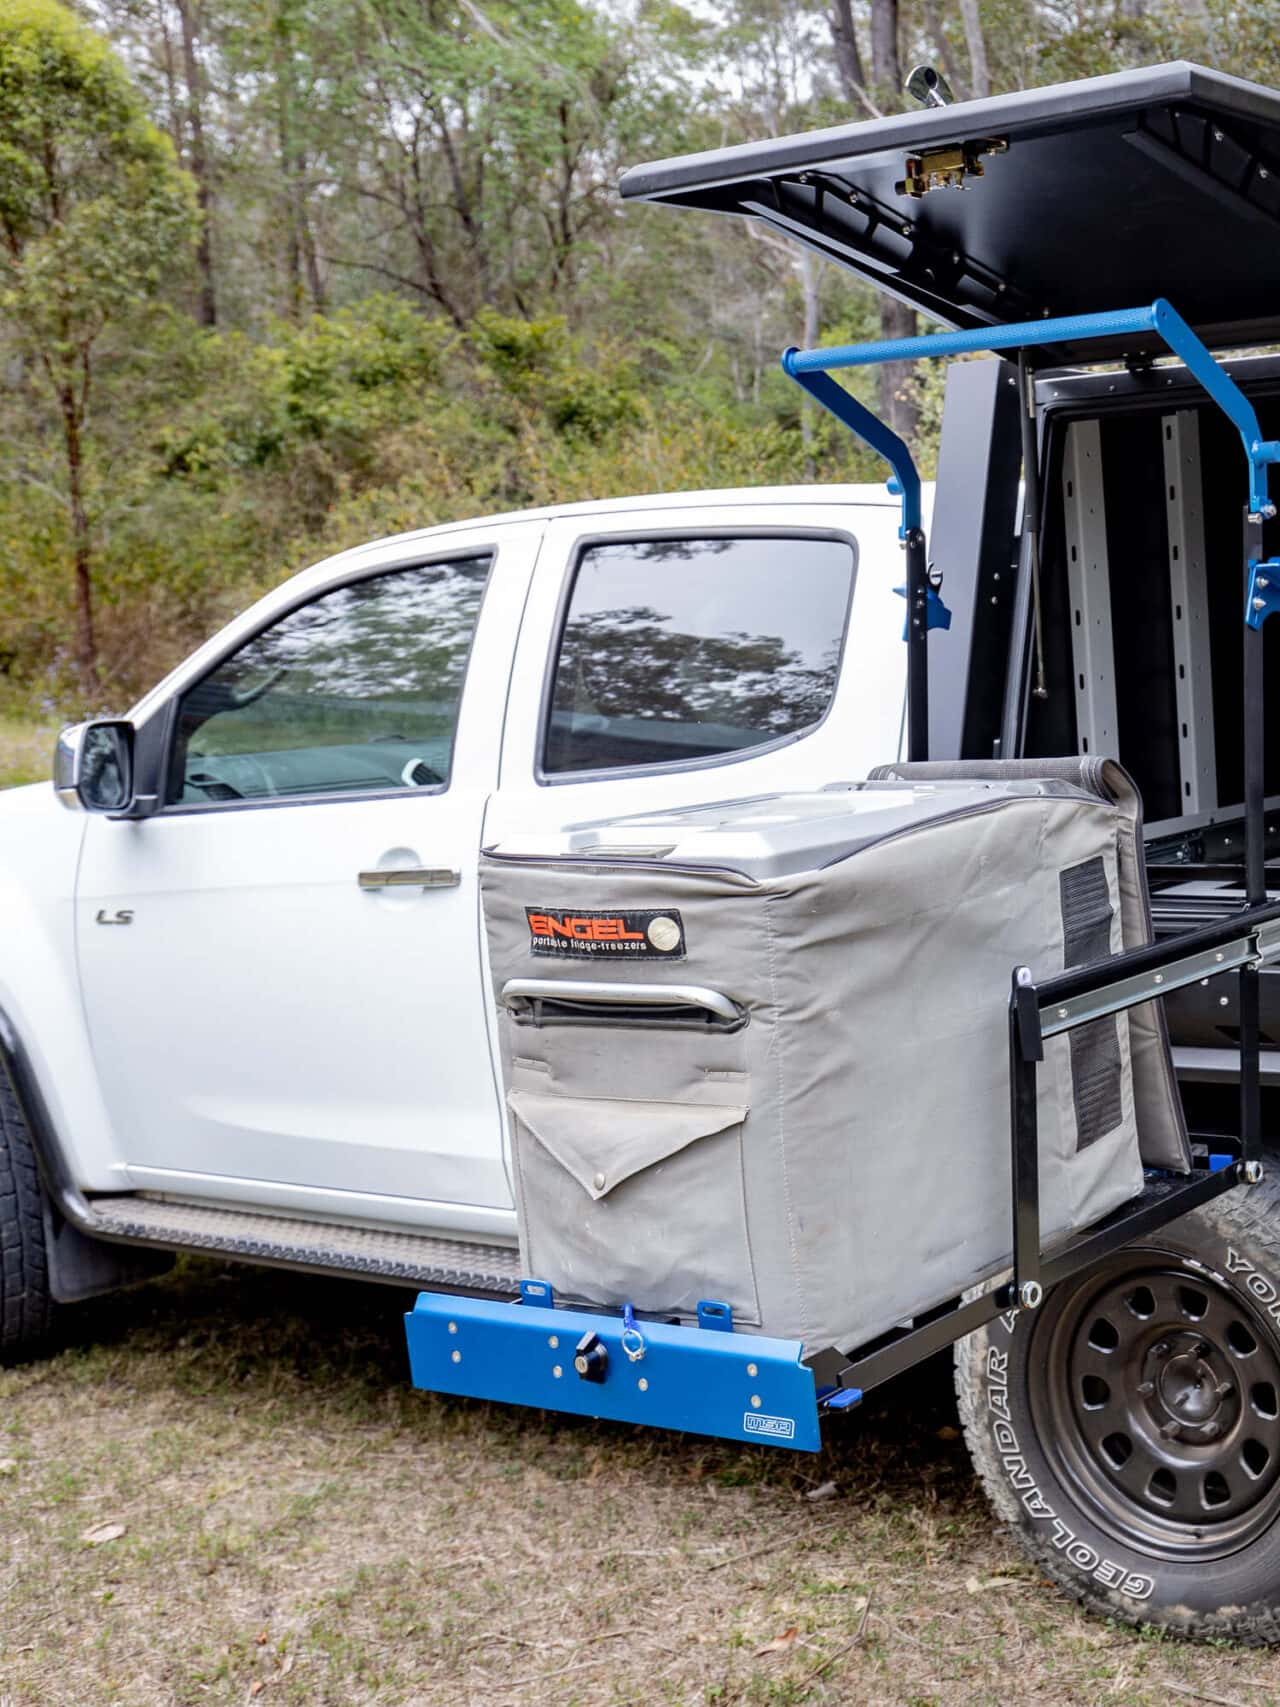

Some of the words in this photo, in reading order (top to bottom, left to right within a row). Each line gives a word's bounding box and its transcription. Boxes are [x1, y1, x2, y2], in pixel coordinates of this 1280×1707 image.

[96, 909, 135, 925] LS
[528, 914, 644, 939] ENGEL
[986, 1346, 1155, 1600] GEOLANDAR
